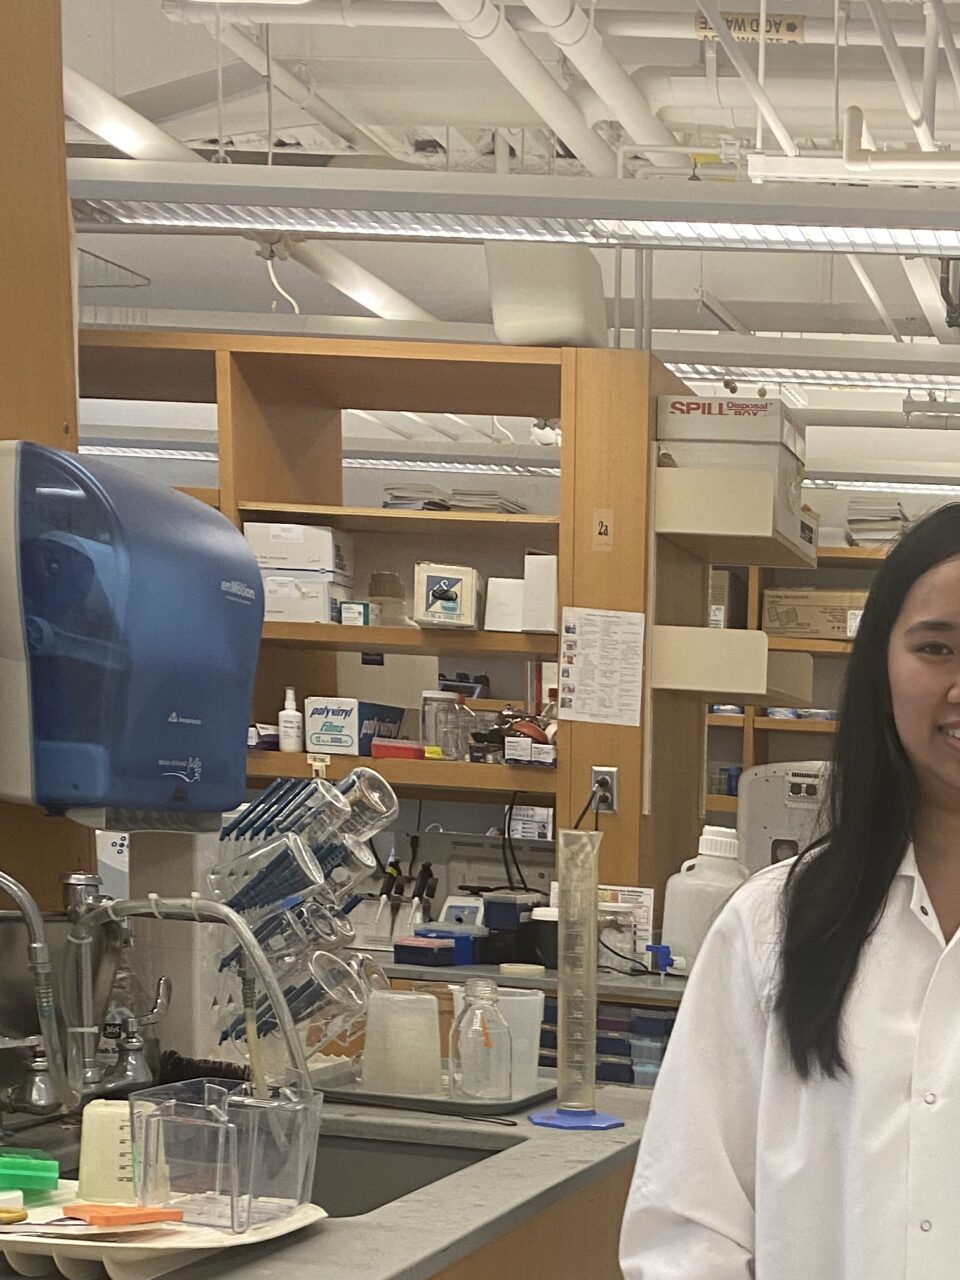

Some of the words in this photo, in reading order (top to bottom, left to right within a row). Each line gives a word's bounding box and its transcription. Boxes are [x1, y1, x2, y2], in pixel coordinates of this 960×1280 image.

[699, 15, 747, 32] WAE
[750, 18, 783, 33] ACD
[669, 400, 729, 416] SPILL
[726, 401, 769, 412] Disposal
[597, 520, 609, 536] 2a
[309, 705, 354, 719] polyvinyl
[320, 721, 345, 733] Films
[104, 1025, 120, 1034] 365
